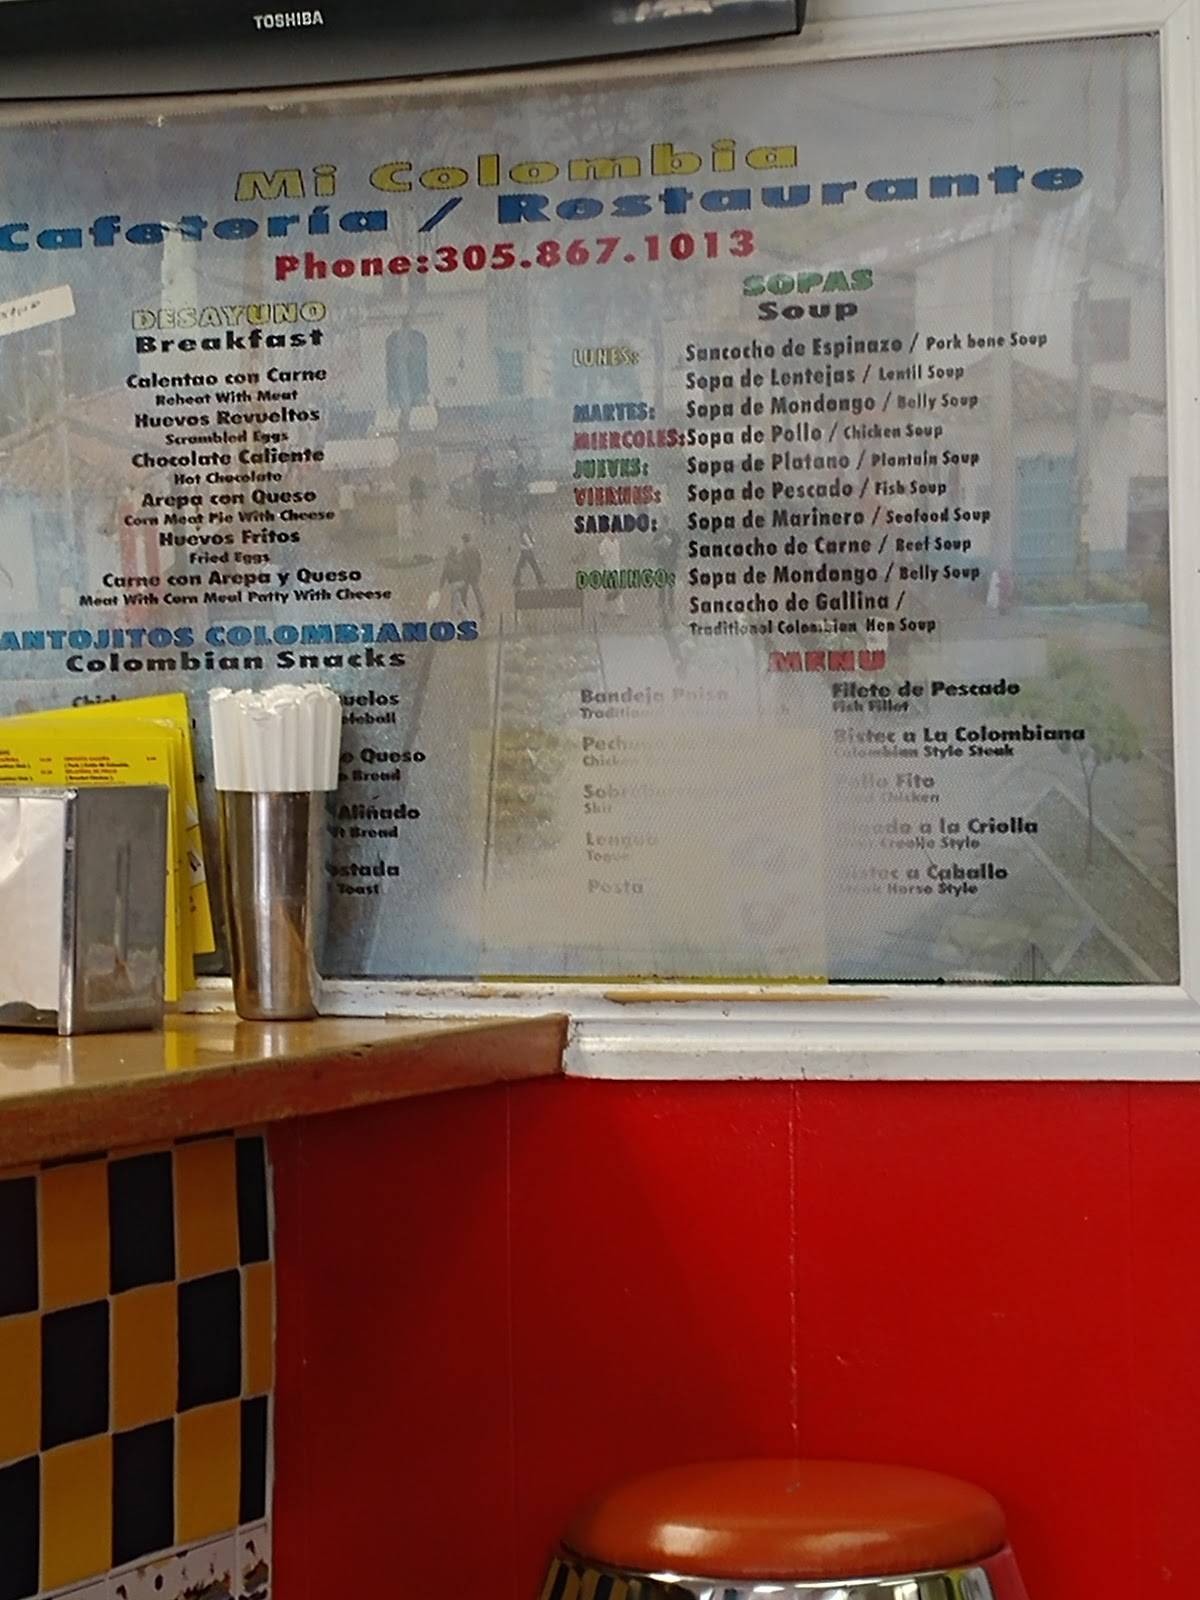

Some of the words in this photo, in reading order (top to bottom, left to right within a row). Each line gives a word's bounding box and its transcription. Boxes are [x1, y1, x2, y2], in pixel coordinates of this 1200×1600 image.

[253, 10, 324, 29] TOSHIBA
[235, 165, 337, 201] Mi
[369, 139, 798, 191] Colombia
[418, 196, 463, 232] /
[498, 164, 1084, 224] Restaurante
[275, 229, 755, 280] Phone:305.867.1013
[743, 268, 874, 297] SOPAS
[132, 301, 326, 330] DESAYUNO
[758, 300, 858, 322] Soup
[136, 329, 324, 353] Breakfast
[686, 340, 775, 362] Sancocho
[782, 338, 805, 357] de
[812, 336, 902, 358] Espinazo
[909, 333, 919, 354] /
[926, 334, 961, 350] Pork
[968, 333, 1005, 348] bone
[1010, 332, 1048, 348] Soup
[126, 373, 218, 389] Calentao
[226, 370, 259, 386] con
[267, 367, 327, 383] Carne
[686, 372, 733, 392] Sopa
[741, 368, 763, 387] de
[771, 365, 855, 387] Lentejas
[862, 364, 871, 384] /
[879, 364, 922, 381] Lentil
[927, 364, 964, 380] Soup
[155, 393, 211, 407] Reheat
[216, 391, 251, 403] With
[257, 389, 298, 402] Meat
[686, 400, 733, 420] Sopa
[741, 397, 763, 415] de
[771, 393, 875, 415] Mondongo
[882, 391, 892, 412] /
[897, 393, 936, 410] Belly
[941, 393, 978, 409] Soup
[135, 412, 209, 429] Huevos
[217, 407, 320, 426] Revueltos
[573, 402, 655, 422] MARTES:
[165, 431, 247, 446] Scrambled
[253, 431, 288, 445] Eggs
[687, 428, 734, 448] Sopa
[741, 425, 764, 444] de
[772, 422, 822, 443] Pollo
[828, 422, 838, 442] /
[844, 423, 901, 440] Chicken
[906, 423, 943, 439] Soup
[132, 449, 231, 468] Chocolate
[239, 447, 325, 464] Caliente
[687, 456, 734, 477] Sopa
[741, 454, 765, 472] de
[772, 451, 850, 472] Platano
[856, 450, 866, 470] /
[872, 450, 938, 468] Plantain
[942, 450, 980, 467] Soup
[174, 473, 200, 485] Hot
[206, 471, 282, 484] Chocolate
[573, 458, 648, 479] JUEVES:
[141, 492, 202, 508] Arepa
[210, 491, 244, 505] con
[252, 489, 317, 504] Queso
[688, 484, 735, 505] Sopa
[741, 481, 765, 500] de
[772, 477, 853, 500] Pescado
[860, 478, 869, 499] /
[875, 481, 905, 495] Fish
[910, 480, 947, 495] Soup
[124, 514, 159, 527] Corn
[209, 512, 232, 525] Pie
[239, 511, 275, 522] With
[279, 508, 335, 521] Cheese
[574, 513, 657, 534] SABADO:
[688, 512, 735, 533] Sopa
[742, 510, 765, 528] de
[772, 507, 864, 528] Marinero
[872, 506, 881, 525] /
[886, 508, 949, 524] Seafood
[953, 507, 991, 523] Soup
[160, 531, 234, 547] Huevos
[241, 529, 300, 544] Fritos
[689, 536, 778, 558] Sancocho
[784, 535, 808, 555] de
[815, 536, 871, 554] Carne
[878, 534, 888, 554] /
[895, 536, 929, 552] Beef
[934, 537, 972, 552] Soup
[189, 552, 229, 564] Fried
[235, 551, 270, 566] Eggs
[103, 572, 160, 588] Carne
[167, 572, 202, 586] con
[208, 570, 270, 588] Arepa
[279, 572, 289, 586] y
[296, 568, 362, 584] Queso
[575, 568, 676, 590] DOMINGO:
[689, 568, 736, 588] Sopa
[743, 565, 767, 583] de
[773, 563, 878, 584] Mondongo
[884, 562, 894, 582] /
[899, 566, 939, 582] Belly
[943, 565, 981, 580] Soup
[79, 595, 118, 608] Meat
[123, 593, 159, 606] With
[164, 593, 198, 606] Corn
[203, 591, 243, 604] Meal
[248, 591, 289, 606] Patty
[294, 589, 331, 602] With
[335, 587, 392, 601] Cheese
[690, 593, 779, 614] Sancocho
[785, 592, 809, 612] de
[816, 591, 889, 610] Gallina
[896, 591, 905, 611] /
[0, 626, 194, 651] ANTOJITOS
[205, 620, 480, 647] COLOMBIANOS
[689, 620, 772, 637] Traditional
[866, 618, 895, 632] Hen
[900, 617, 936, 632] Soup
[66, 651, 263, 673] Colombian
[276, 648, 407, 669] Snacks
[769, 650, 886, 672] MENU
[579, 687, 664, 705] Bandeja
[832, 683, 891, 698] Filete
[898, 680, 924, 697] de
[931, 679, 1020, 697] Pescado
[832, 700, 863, 713] Fish
[903, 730, 916, 743] a
[923, 727, 947, 742] La
[955, 725, 1085, 743] Colombiana
[360, 748, 426, 764] Queso
[923, 744, 963, 759] Style
[969, 744, 1014, 757] Steak
[338, 803, 420, 819] Aliñado
[919, 822, 932, 834] a
[940, 817, 960, 834] la
[967, 817, 1038, 834] Criolla
[941, 836, 980, 850] Style
[907, 866, 919, 879] a
[927, 863, 1008, 880] Caballo
[887, 882, 933, 894] Horse
[938, 881, 978, 897] Style
